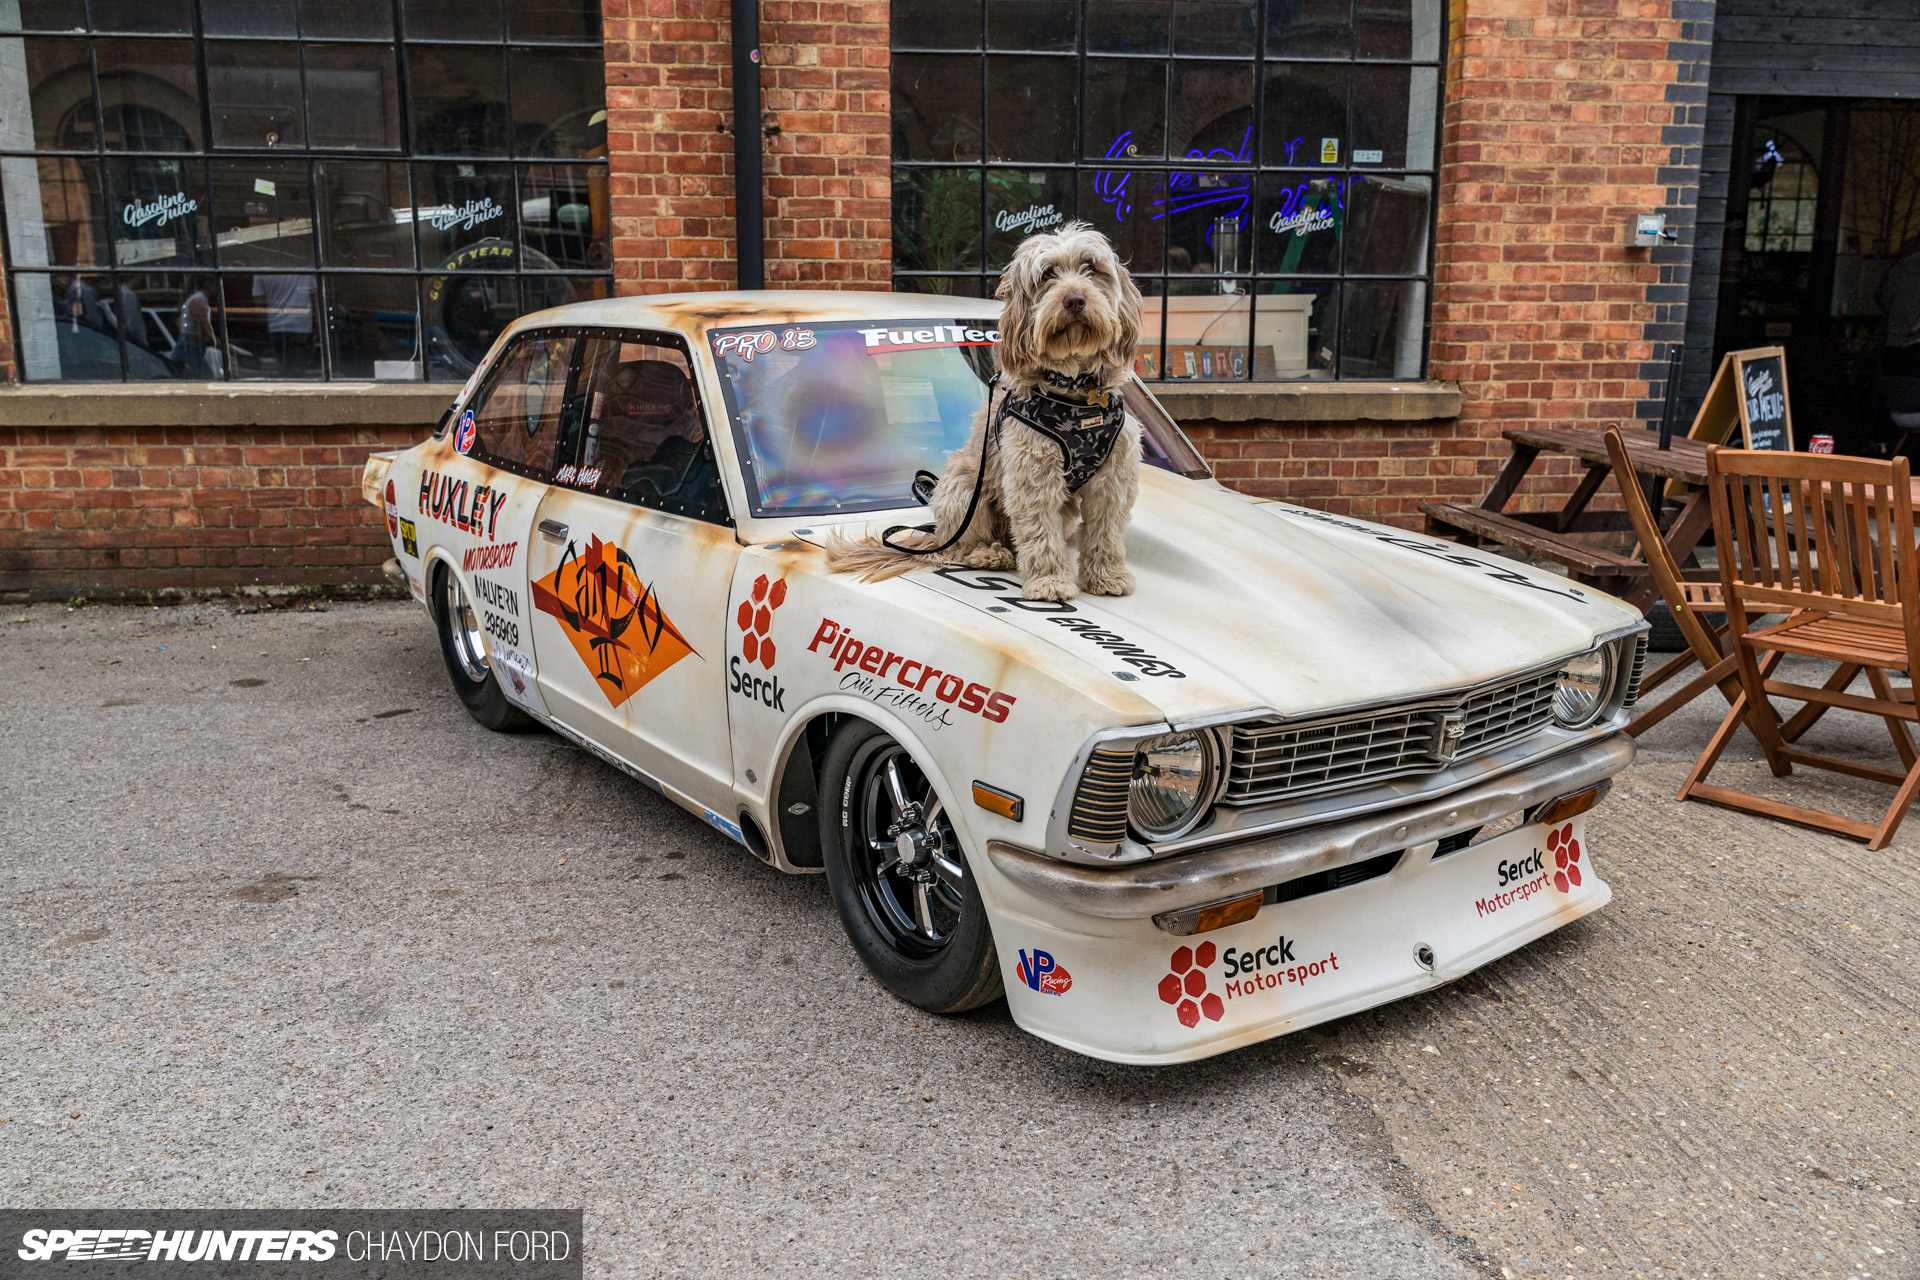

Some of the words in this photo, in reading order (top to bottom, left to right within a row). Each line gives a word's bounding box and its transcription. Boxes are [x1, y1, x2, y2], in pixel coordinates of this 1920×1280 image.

[123, 192, 186, 227] Gasoline
[431, 197, 493, 231] Gasoline
[995, 204, 1054, 232] Gasoline
[1269, 209, 1328, 234] Gasoline
[430, 246, 513, 301] GODYEAR
[715, 331, 777, 363] PRO
[781, 328, 818, 351] 85
[857, 325, 1003, 348] FuelTec
[418, 469, 507, 542] HUXLEY
[462, 541, 518, 573] MOTORSPORT
[1046, 617, 1187, 679] ENGINES
[730, 655, 786, 713] Serck
[807, 617, 1018, 724] Pipercross
[872, 686, 954, 732] Filters
[1497, 847, 1544, 887] Serck
[1475, 872, 1551, 918] Motorsport
[1018, 948, 1055, 992] VP
[1222, 935, 1296, 979] Serck
[1225, 952, 1339, 1000] Motorsport
[1042, 975, 1072, 989] Racing
